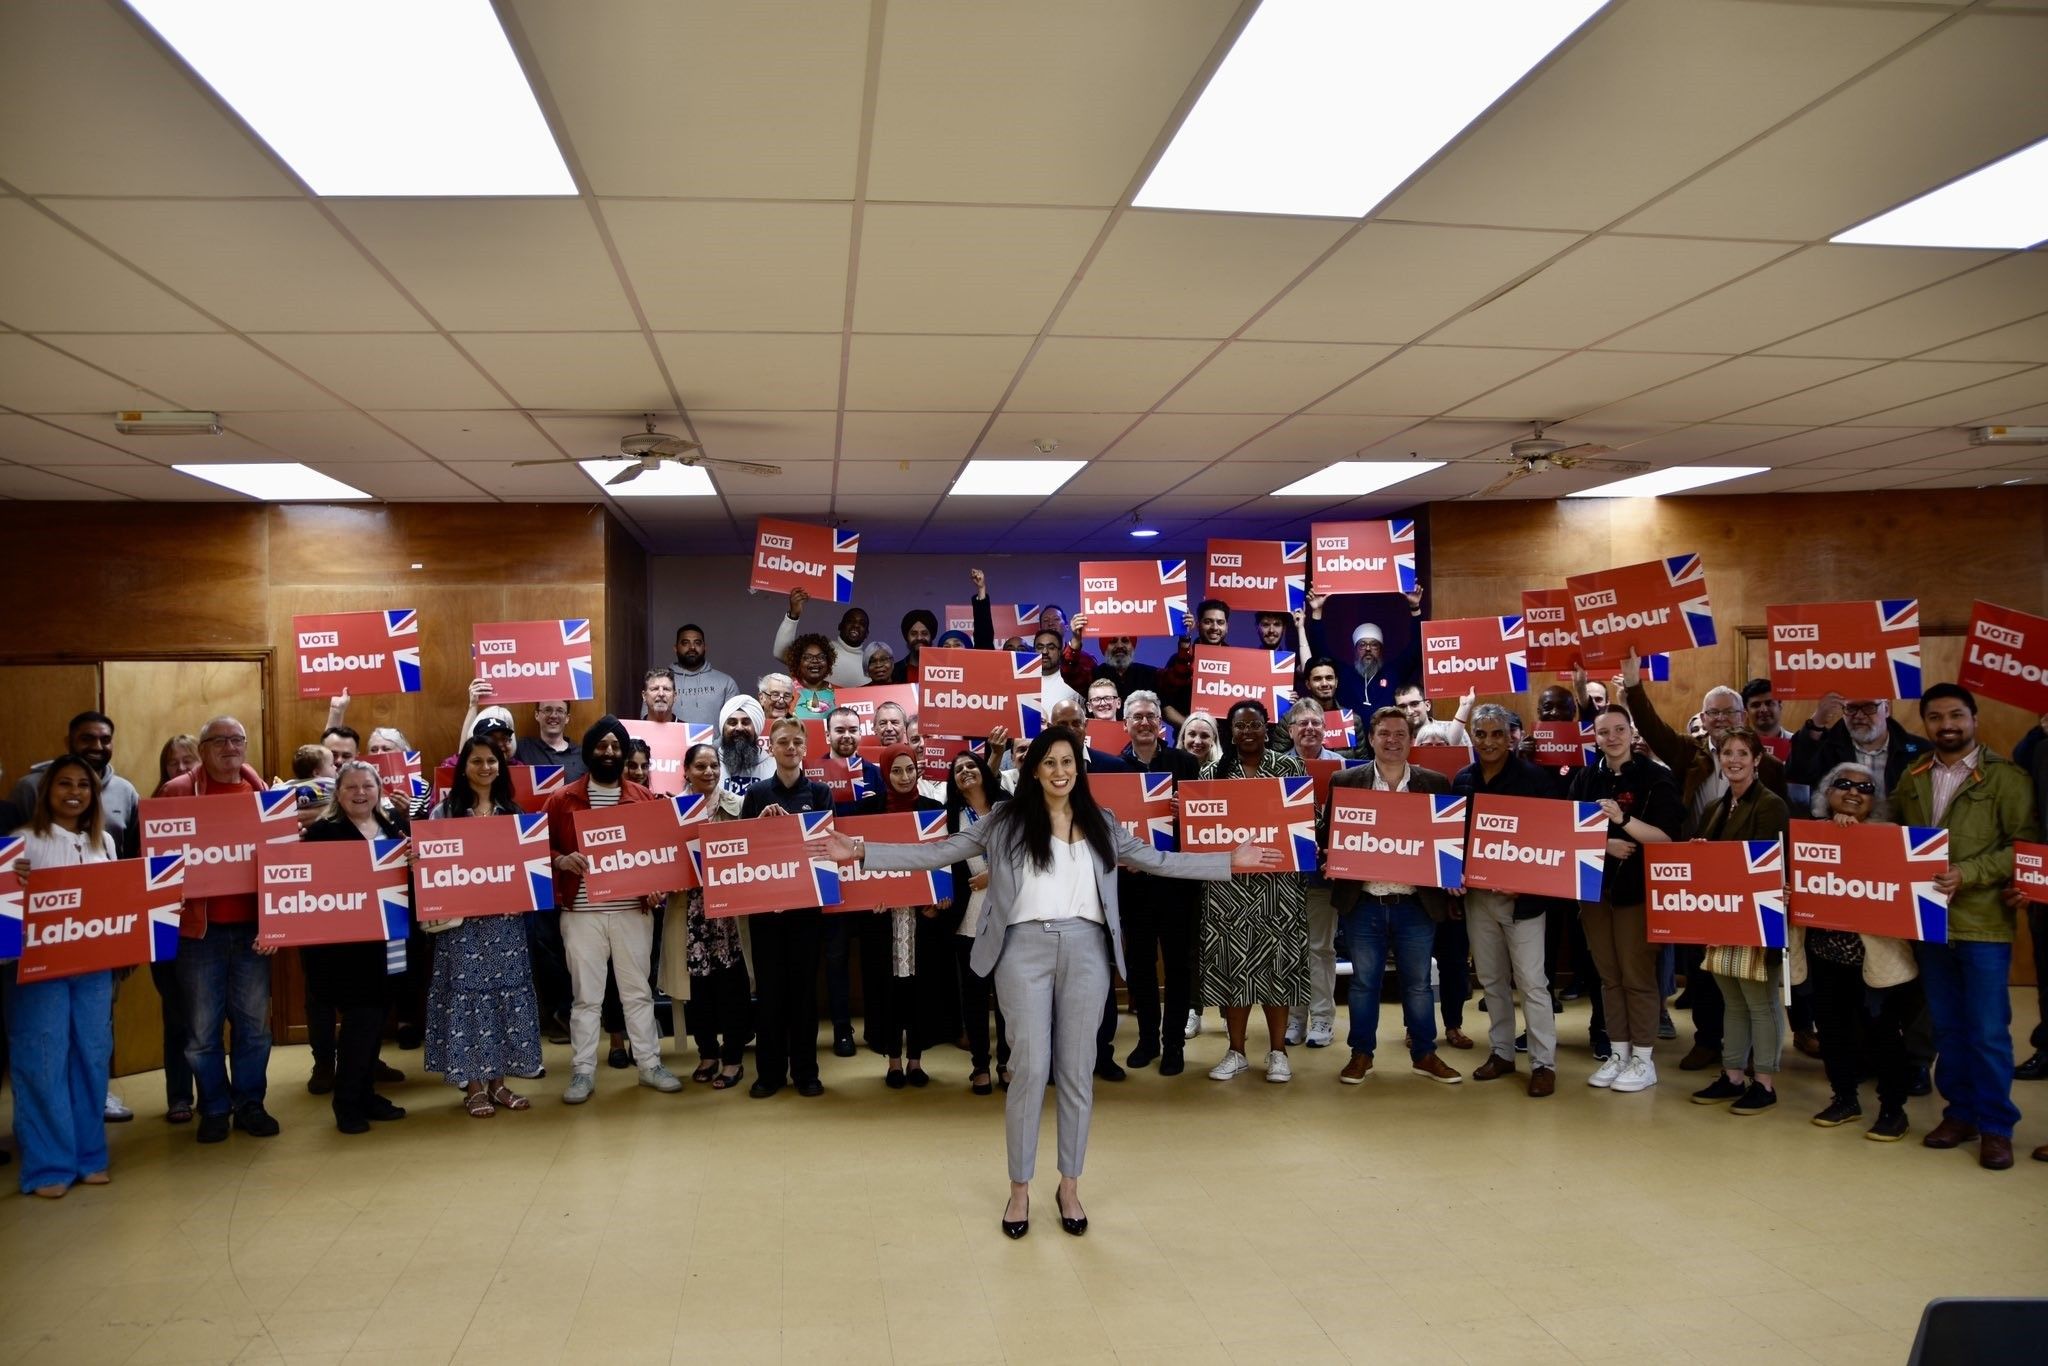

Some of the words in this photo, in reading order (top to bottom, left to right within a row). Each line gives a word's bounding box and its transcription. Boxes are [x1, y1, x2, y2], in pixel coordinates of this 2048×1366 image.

[764, 535, 790, 548] VOTE
[1319, 538, 1346, 548] VOTE
[758, 551, 826, 577] Labour
[1213, 555, 1239, 565] VOTE
[1317, 555, 1387, 572] Labour
[1087, 580, 1115, 589] VOTE
[1210, 571, 1278, 590] Labour
[1085, 596, 1157, 614] Labour
[1577, 592, 1613, 609] VOTE
[1529, 609, 1561, 620] VOTE
[1580, 606, 1670, 638] Labour
[952, 620, 973, 629] VOT
[1776, 627, 1815, 638] VOTE
[302, 634, 336, 645] VOTE
[1528, 627, 1580, 648] Labo
[1980, 624, 2020, 645] VOTE
[482, 642, 513, 652] VOTE
[1430, 638, 1457, 648] VOTE
[301, 652, 385, 673] Labour
[1201, 661, 1228, 673] VOTE
[1428, 654, 1499, 675] Labour
[1775, 649, 1876, 671] Labour
[1969, 643, 2048, 686] Labo
[481, 660, 560, 679] Labour
[928, 668, 960, 680] VOTE
[1196, 677, 1266, 699] Labour
[924, 689, 1008, 711] Labour
[925, 759, 952, 769] Labo
[1189, 802, 1224, 813] VOTE
[1338, 810, 1373, 822] VOTE
[1479, 817, 1515, 830] VOTE
[149, 820, 192, 833] VOTE
[1187, 823, 1279, 845] Labour
[586, 829, 623, 843] VOTE
[1332, 830, 1424, 856] Labour
[422, 842, 460, 854] VOTE
[709, 841, 745, 855] VOTE
[1472, 837, 1565, 867] Labour
[1798, 846, 1837, 860] VOTE
[587, 845, 678, 875] Labour
[2018, 855, 2040, 865] VOTE
[267, 867, 308, 879] VOTE
[420, 864, 516, 888] Labour
[707, 858, 800, 886] Labour
[1653, 866, 1688, 878] VOTE
[1794, 869, 1899, 902] Labour
[34, 892, 77, 908] VOTE
[264, 890, 367, 915] Labour
[1651, 888, 1743, 913] Labour
[26, 913, 138, 947] Labour
